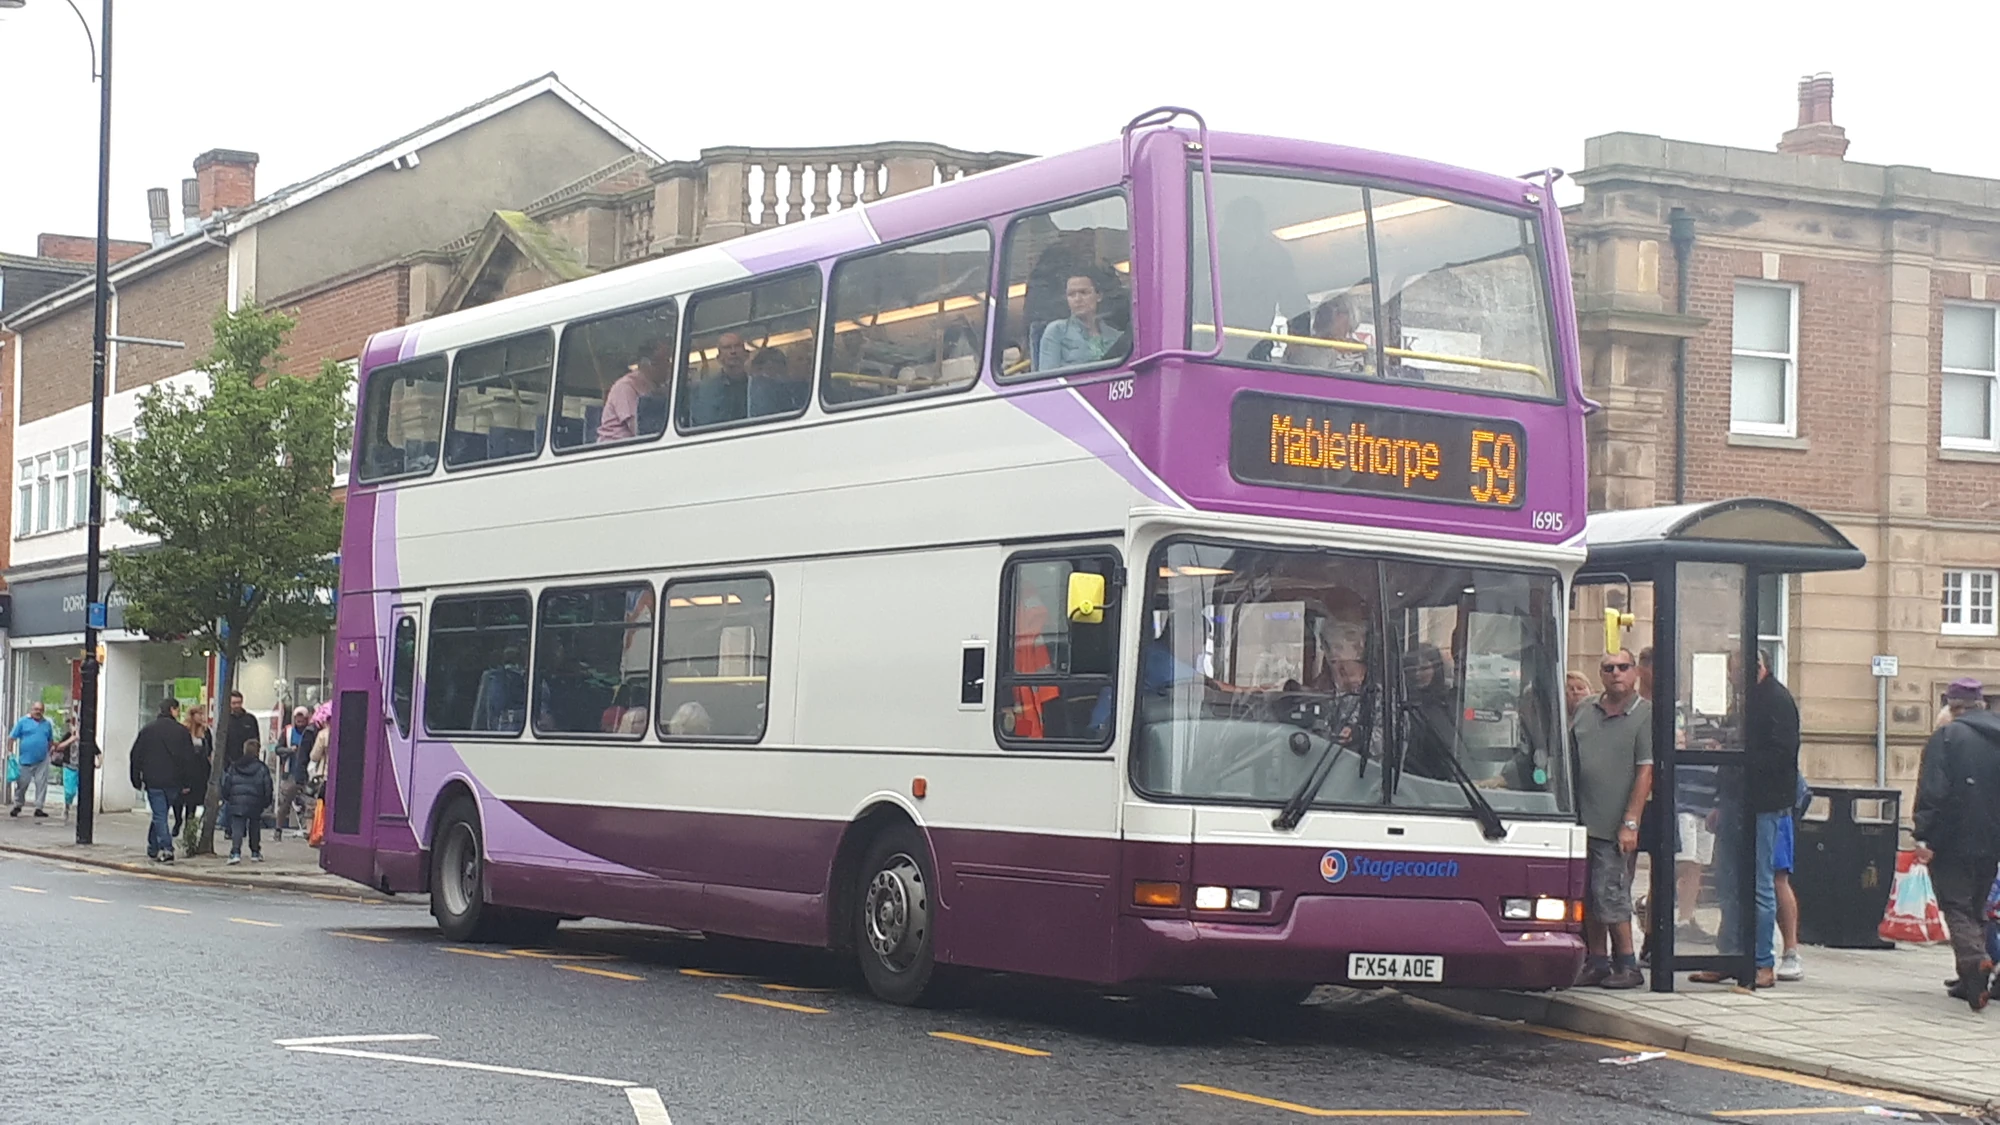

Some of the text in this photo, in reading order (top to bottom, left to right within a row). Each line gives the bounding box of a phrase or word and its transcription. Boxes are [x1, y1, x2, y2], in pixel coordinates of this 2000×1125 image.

[1108, 379, 1134, 401] 16915
[1269, 413, 1518, 504] Mablethorpe 59
[1532, 510, 1563, 531] 16915
[1351, 855, 1459, 882] Stagecoach
[1354, 957, 1435, 978] FX54 AOE
